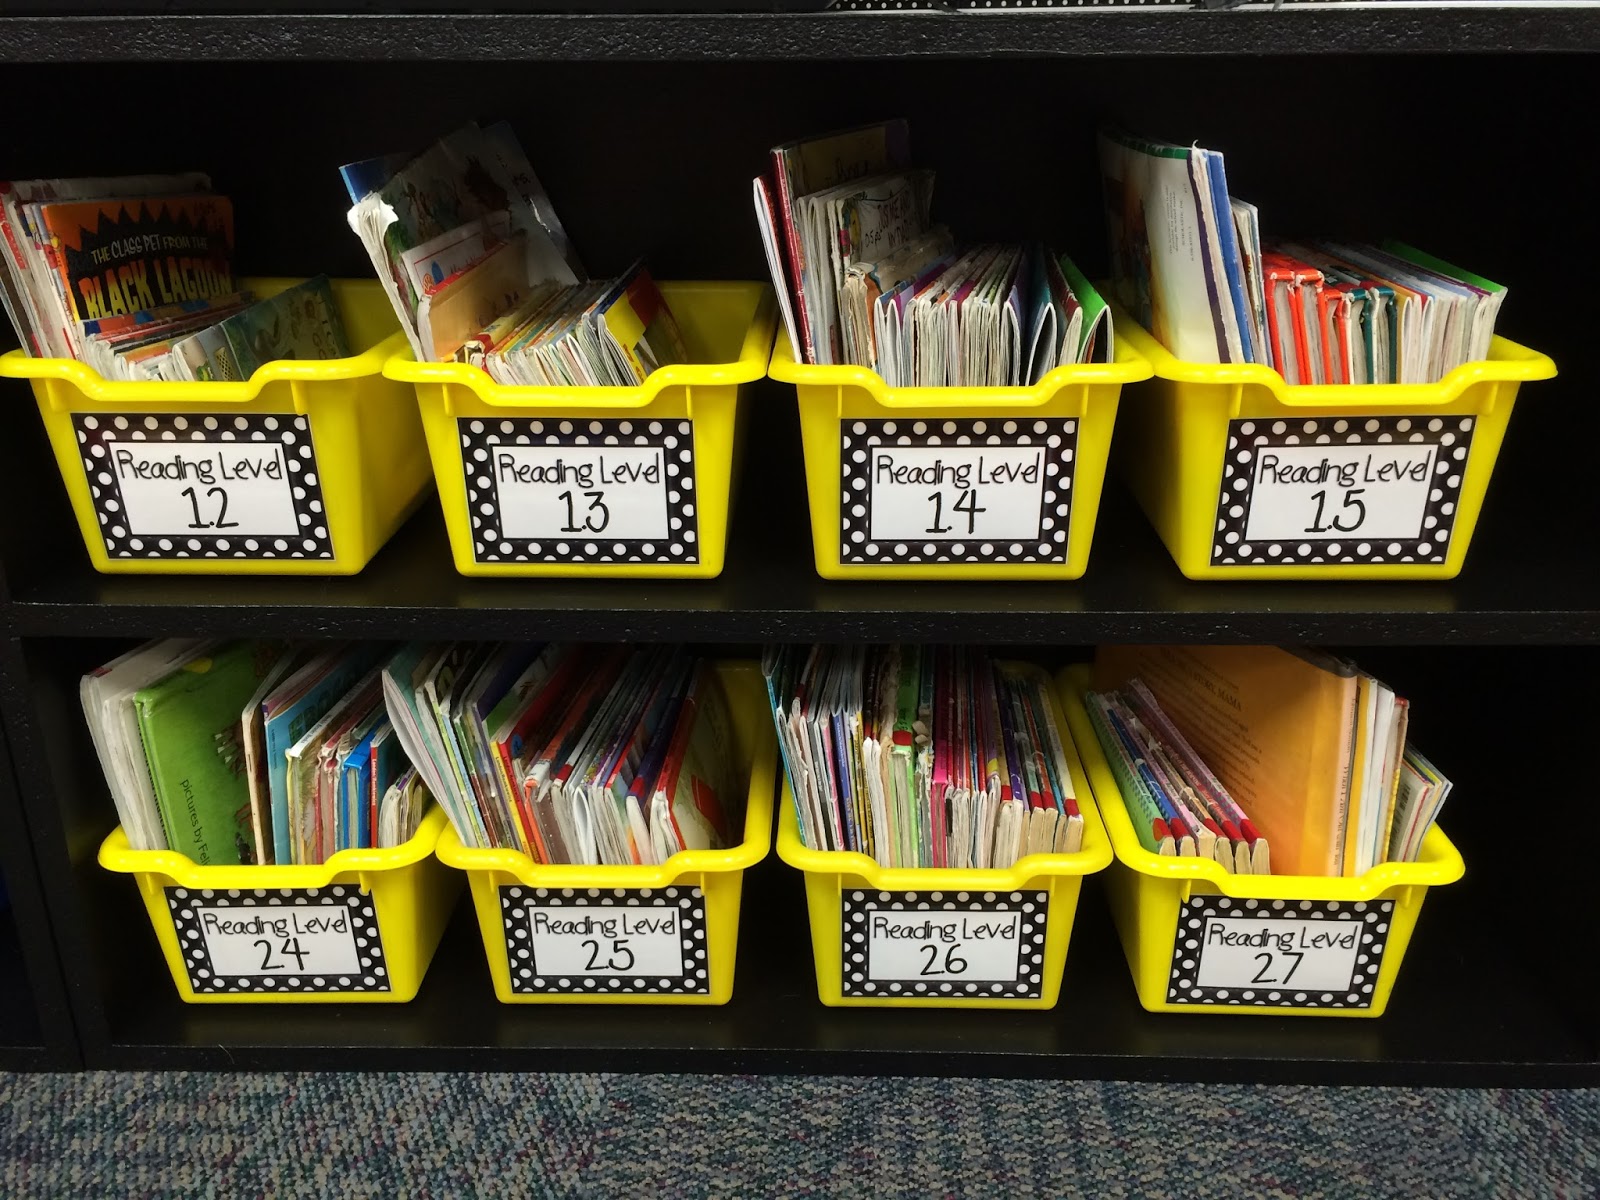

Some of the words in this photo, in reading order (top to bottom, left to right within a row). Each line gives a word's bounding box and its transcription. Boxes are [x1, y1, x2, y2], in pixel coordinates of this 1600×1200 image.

[91, 247, 112, 265] THE
[111, 236, 143, 259] CLASS
[143, 233, 160, 253] PET
[162, 235, 192, 251] FROM
[77, 258, 158, 320] BLACK
[153, 255, 233, 306] LAGOON
[116, 449, 216, 485] Reading
[218, 448, 282, 480] Level
[499, 453, 594, 488] Reading
[600, 452, 660, 484] Level
[877, 454, 972, 489] Reading
[978, 452, 1040, 484] Level
[1259, 454, 1359, 487] Reading
[1364, 450, 1432, 482] Level
[181, 487, 239, 529] 1.2
[558, 490, 610, 533] 1.3
[925, 489, 986, 534] 1.4
[1304, 488, 1366, 533] 1.5
[1218, 688, 1242, 712] MAMA
[180, 779, 199, 827] pictures
[193, 826, 203, 844] by
[203, 912, 290, 938] Reading
[292, 909, 347, 934] Level
[534, 912, 618, 938] Reading
[622, 911, 676, 935] Level
[873, 916, 957, 943] Reading
[962, 915, 1017, 940] Level
[1208, 923, 1296, 951] Reading
[1299, 925, 1359, 950] Level
